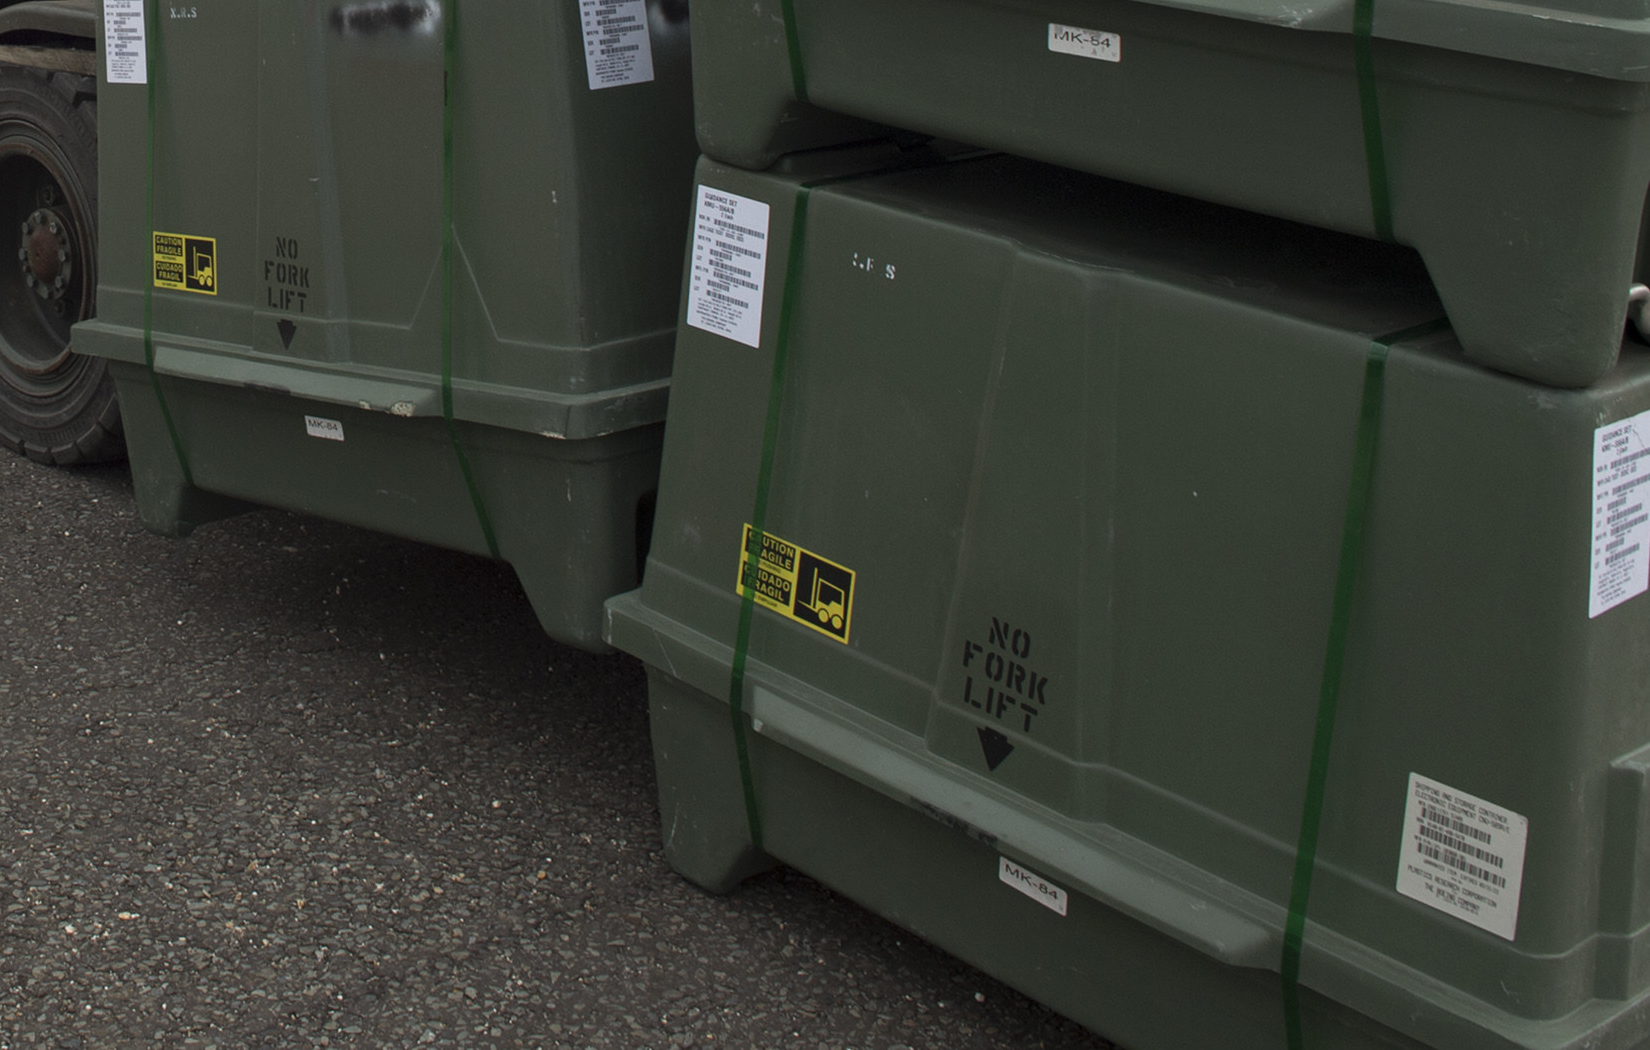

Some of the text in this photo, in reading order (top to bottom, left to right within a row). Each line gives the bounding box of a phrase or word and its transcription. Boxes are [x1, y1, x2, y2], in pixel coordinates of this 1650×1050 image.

[705, 192, 737, 207] GUIDANCE SET
[156, 236, 182, 246] CAUTION
[156, 245, 182, 256] FRAGILE
[276, 236, 298, 259] NO
[156, 262, 183, 272] CUIDADO
[159, 271, 181, 281] FRAGIL
[264, 260, 309, 288] FORK
[268, 287, 307, 312] LIFT
[308, 419, 337, 431] MK-84
[749, 530, 794, 559] CUTION
[745, 563, 790, 592] CIDADO
[989, 616, 1031, 659] NO
[963, 640, 1048, 705] FORK
[964, 676, 1038, 732] LIFT
[1005, 863, 1058, 900] MK-84
